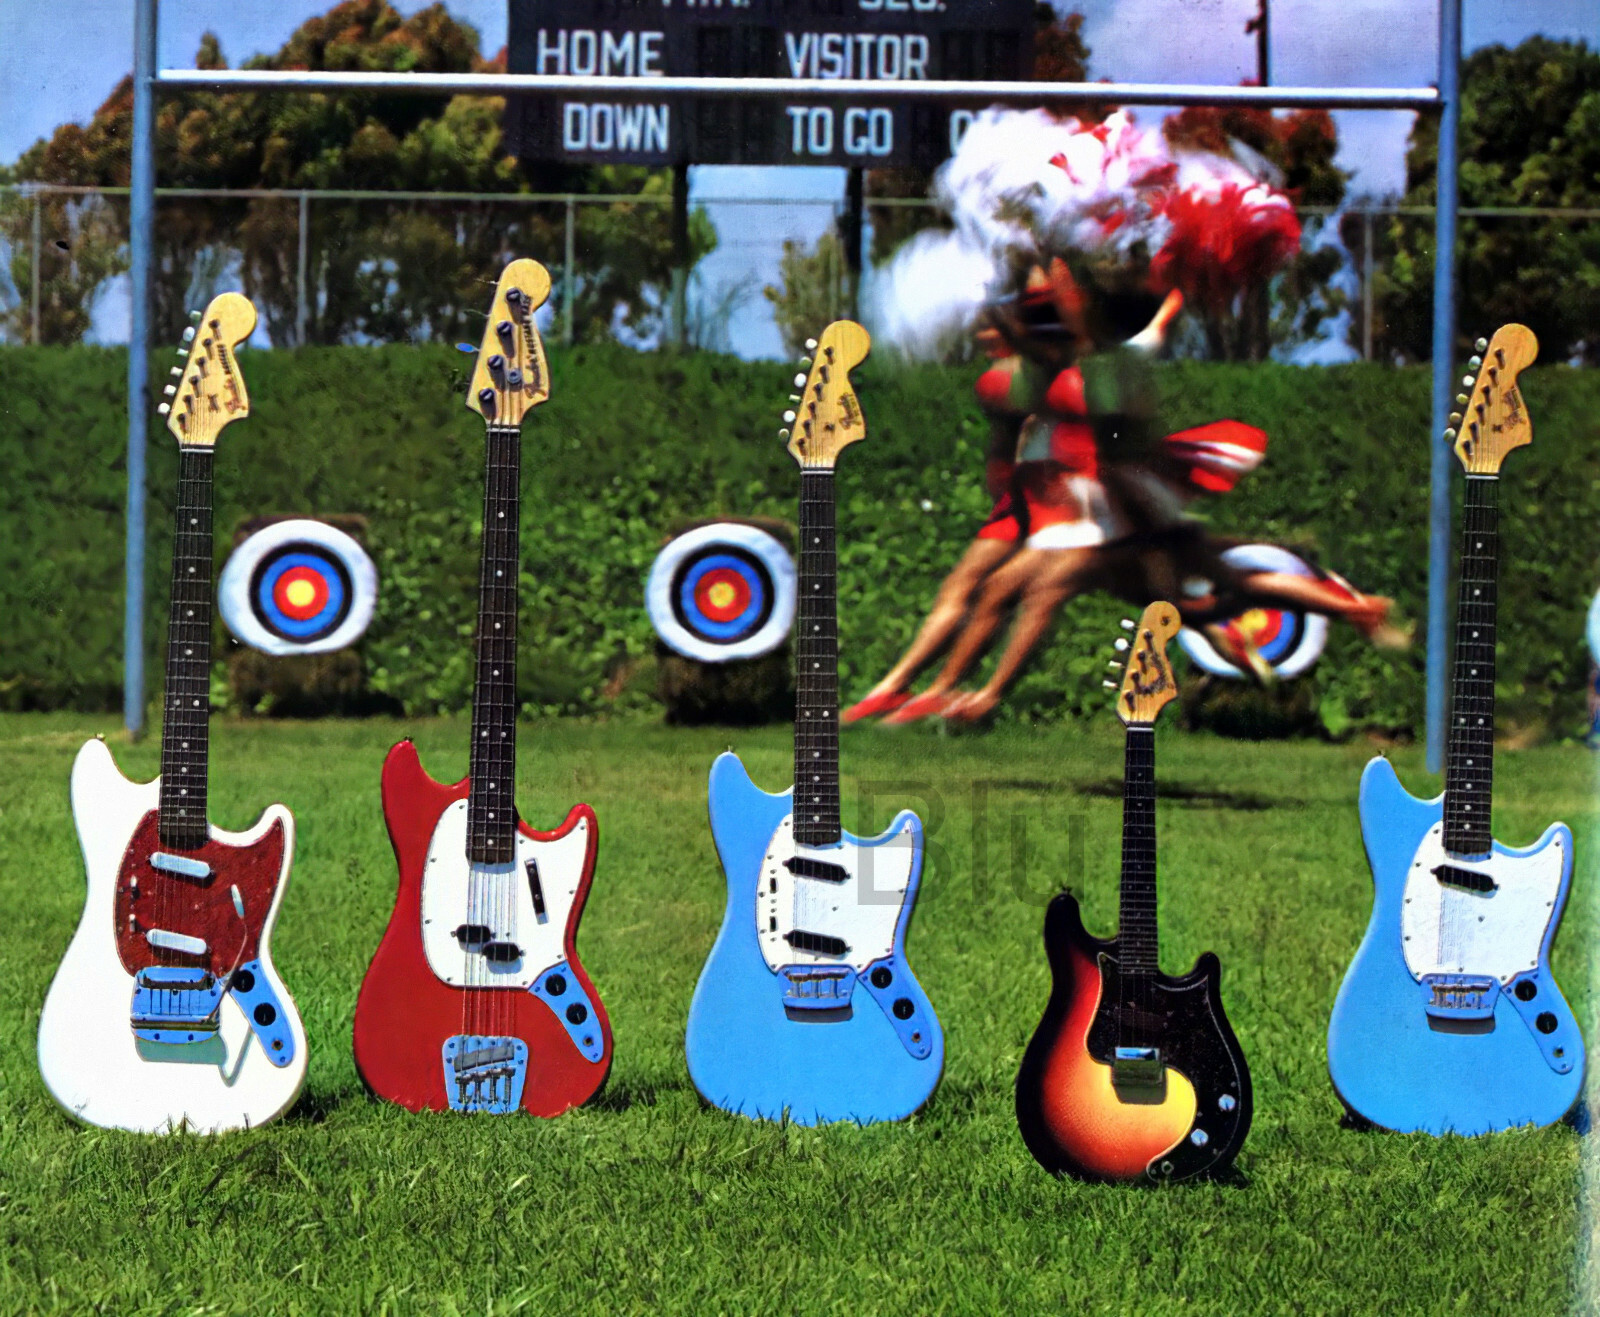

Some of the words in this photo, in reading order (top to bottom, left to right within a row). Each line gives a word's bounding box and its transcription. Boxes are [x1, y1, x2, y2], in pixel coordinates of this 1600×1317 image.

[537, 29, 664, 76] HOME
[785, 32, 929, 80] VISITOR
[563, 103, 670, 152] DOWN
[786, 106, 834, 155] TO
[843, 107, 893, 155] GO
